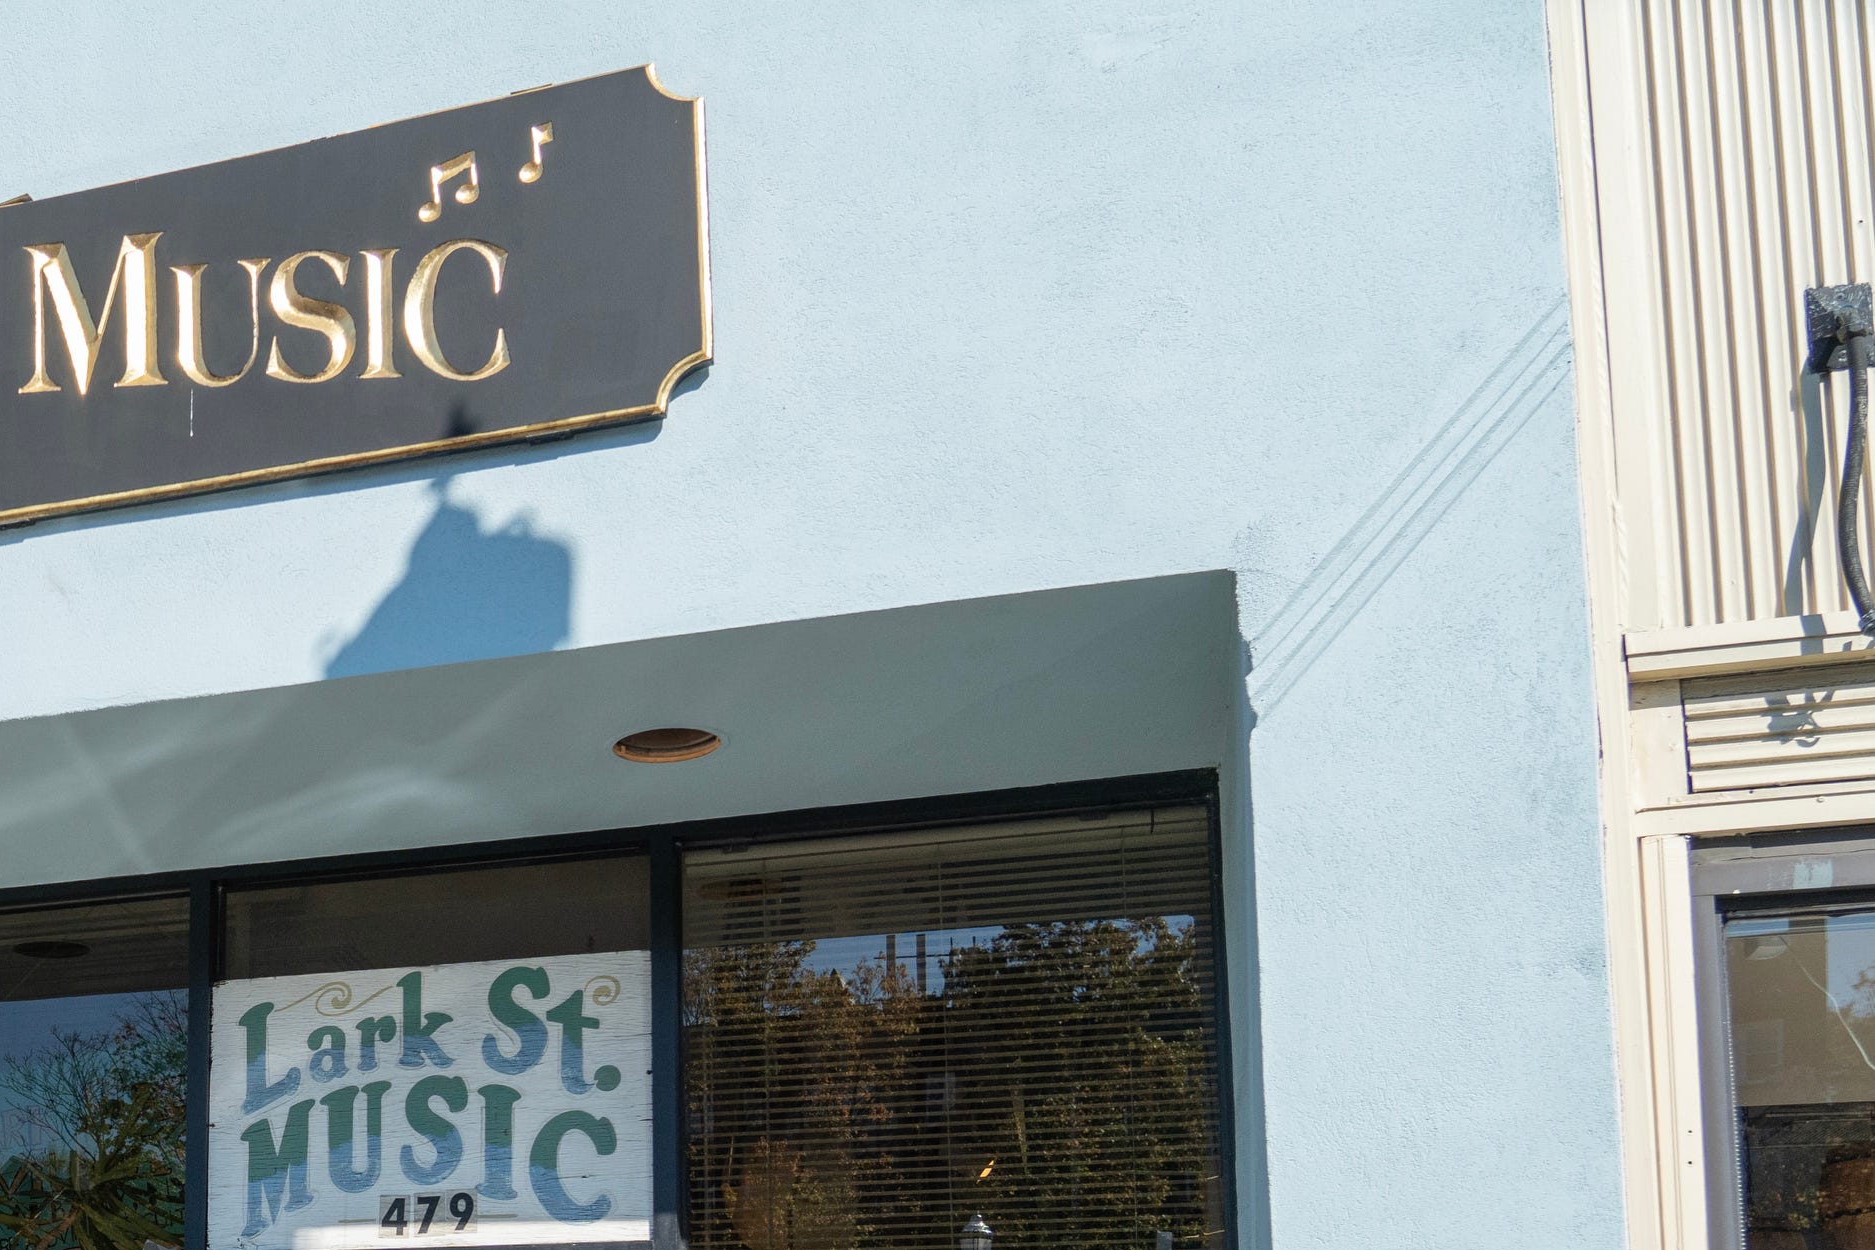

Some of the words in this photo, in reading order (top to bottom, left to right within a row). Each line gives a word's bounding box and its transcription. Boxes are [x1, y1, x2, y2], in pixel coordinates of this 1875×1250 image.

[18, 231, 512, 396] MUSIC
[238, 971, 457, 1115] Lark
[481, 966, 623, 1095] St.
[239, 1074, 619, 1239] MUSIC
[380, 1190, 476, 1237] 479
